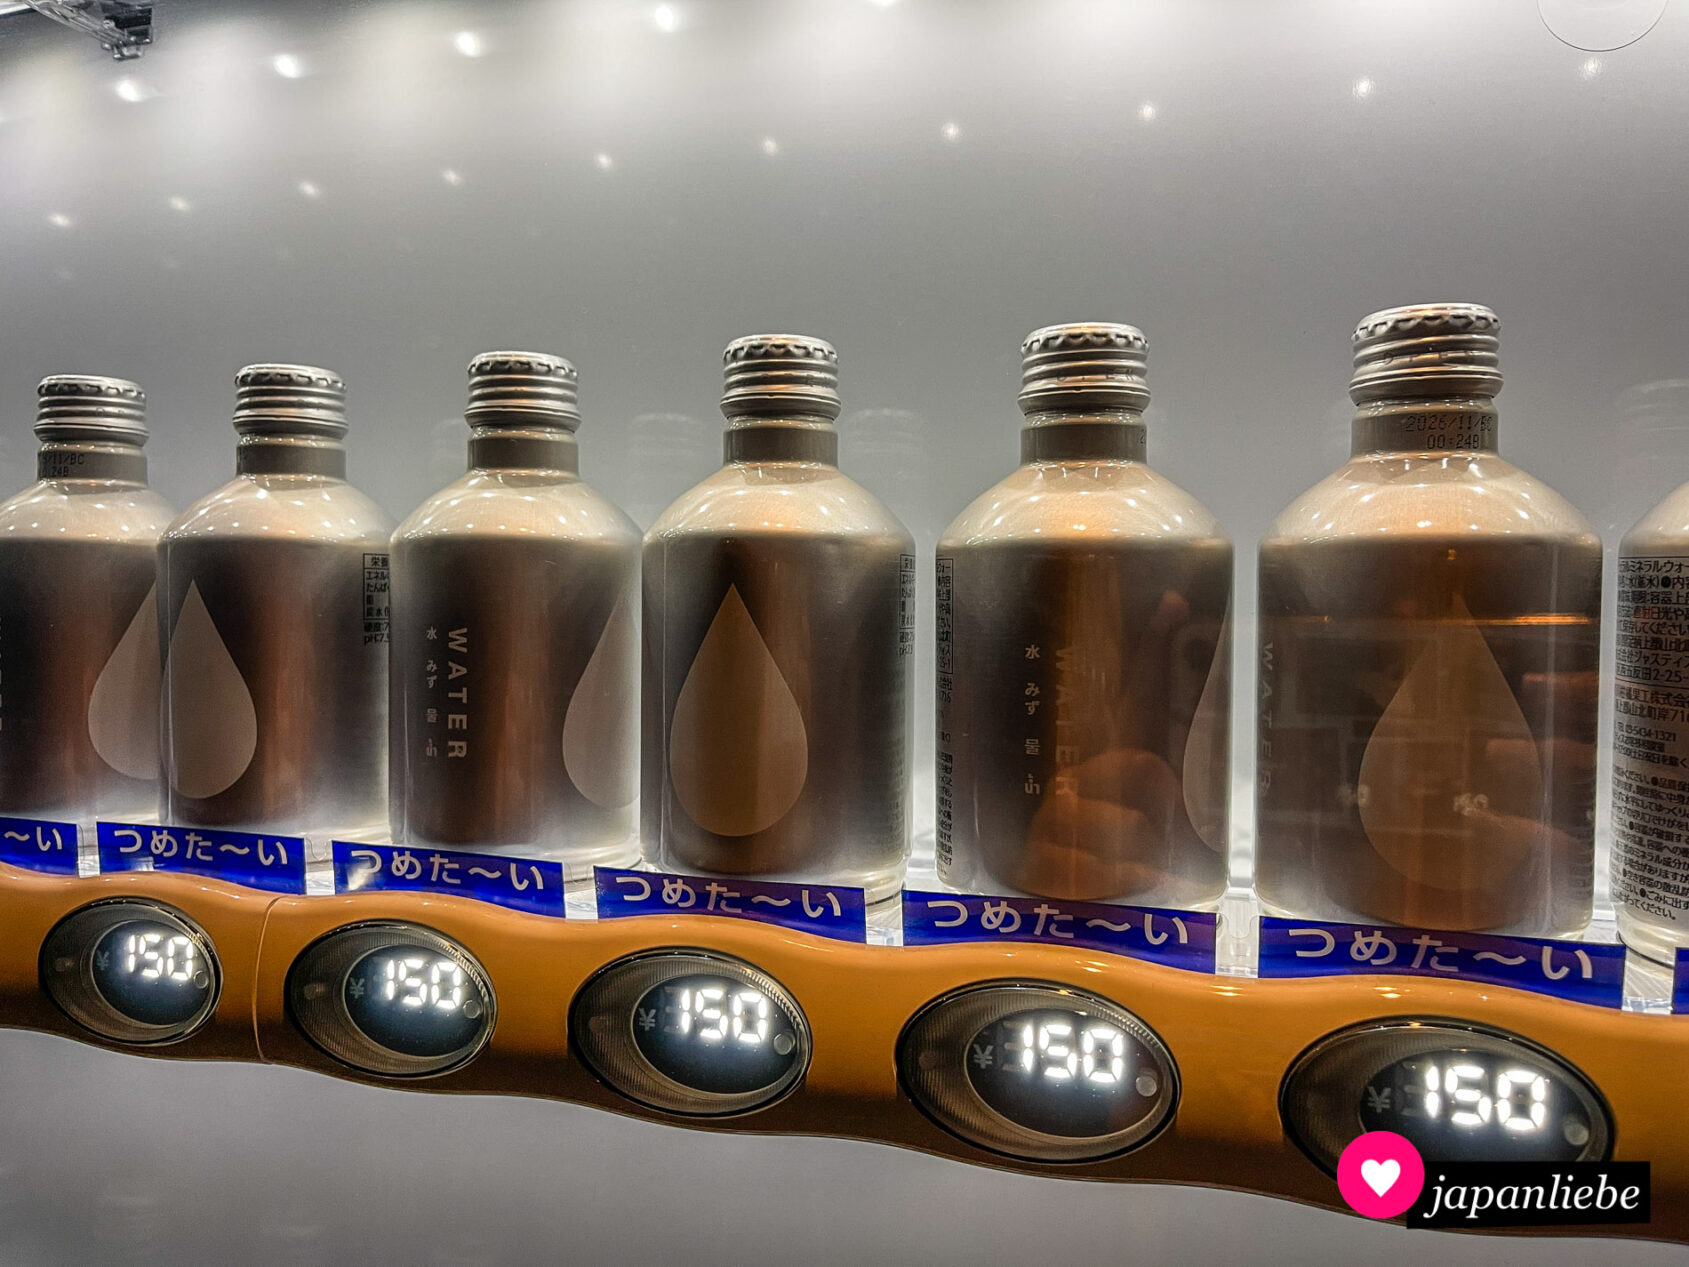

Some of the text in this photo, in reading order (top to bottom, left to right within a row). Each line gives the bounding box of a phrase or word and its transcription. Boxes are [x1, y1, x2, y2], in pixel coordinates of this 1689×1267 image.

[426, 626, 438, 640] 水
[1025, 644, 1041, 660] 水
[448, 627, 468, 758] WATER
[1024, 738, 1041, 756] 물
[127, 933, 194, 981] 150
[384, 958, 463, 1009] 150
[678, 988, 769, 1044] 150
[1022, 1023, 1125, 1084] 150
[1424, 1064, 1547, 1132] 150
